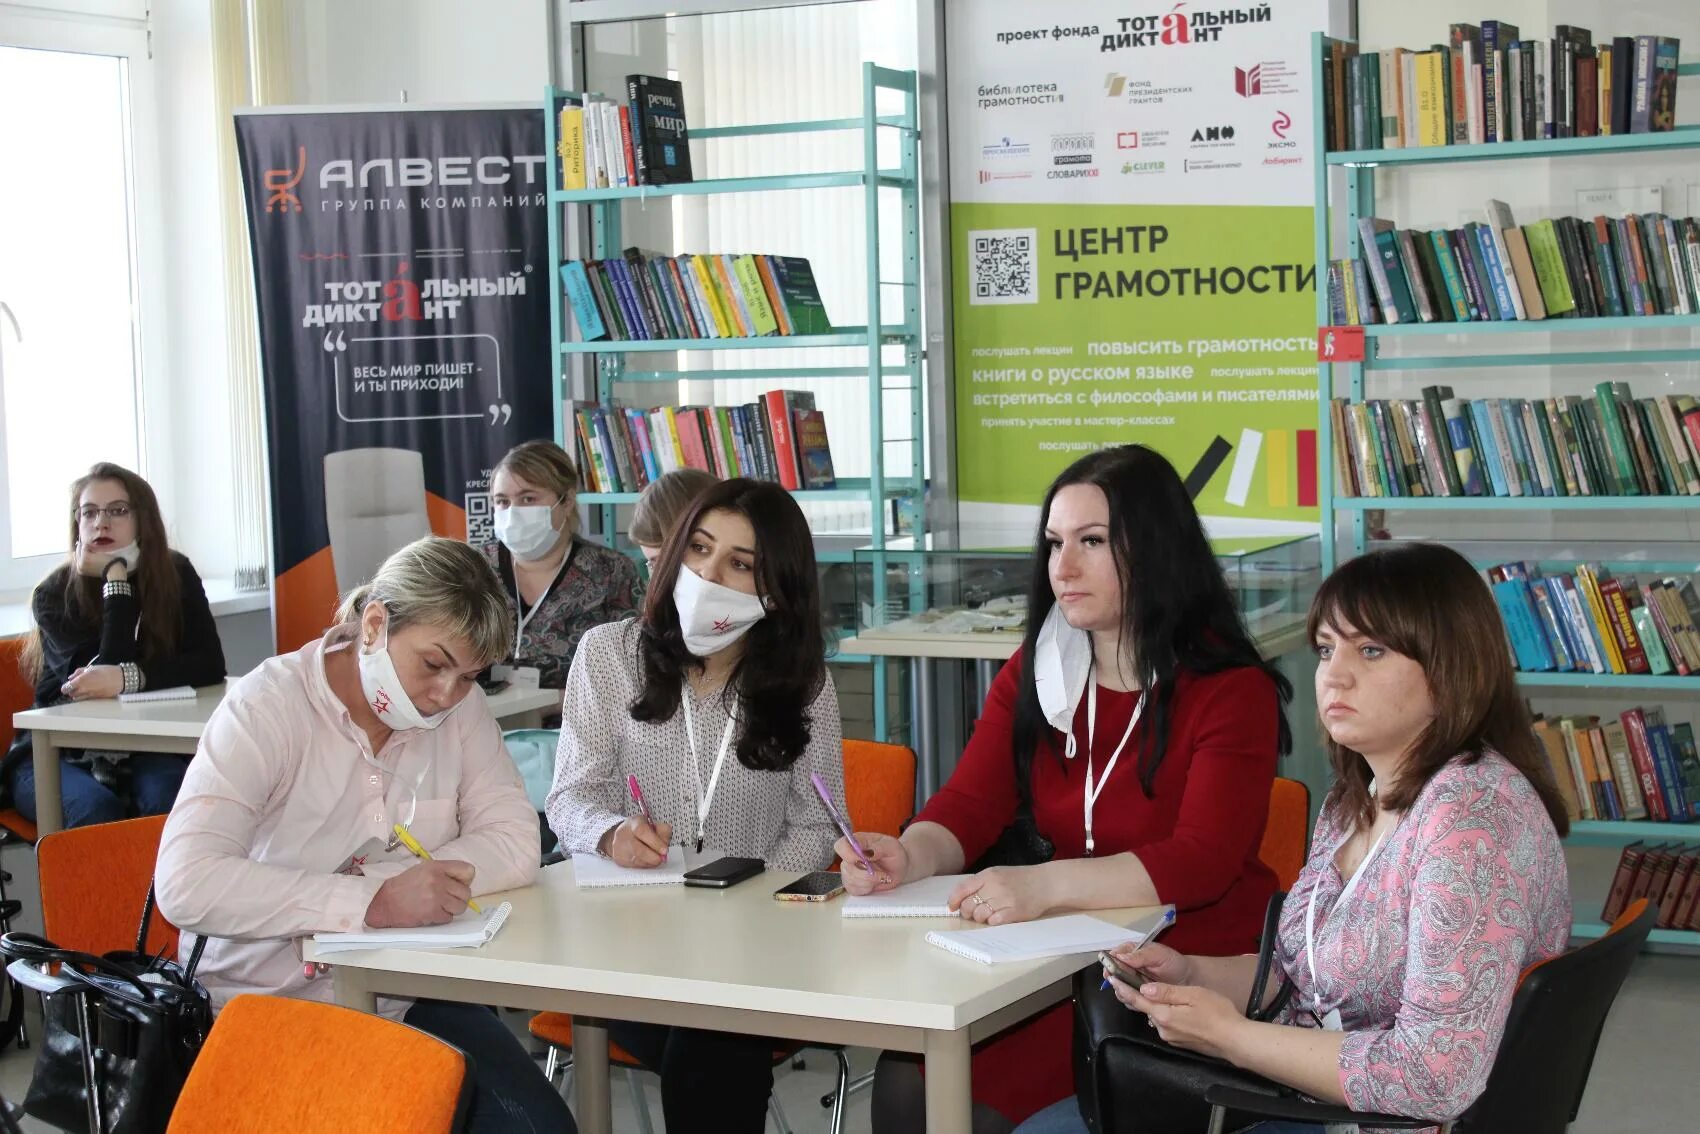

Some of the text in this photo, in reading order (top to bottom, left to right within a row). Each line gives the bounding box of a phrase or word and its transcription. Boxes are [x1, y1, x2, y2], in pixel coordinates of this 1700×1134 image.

[997, 24, 1099, 44] проект фонда
[1129, 81, 1152, 89] ФОНД
[1129, 87, 1192, 97] ПРЕЗИДЕНТСКИХ
[648, 94, 676, 109] речи,
[654, 115, 685, 138] мир
[319, 155, 546, 189] АЛВЕСТ
[1133, 161, 1165, 171] CLEVER
[321, 193, 546, 212] ГРУППА КОМПАНИЙ
[1054, 225, 1168, 262] ЦЕНТР
[1055, 264, 1317, 300] ГРАМОТНОСТИ
[972, 346, 1073, 358] послушать лекции
[1088, 338, 1318, 358] повысить грамотность
[354, 366, 387, 378] ВЕСЬ
[390, 364, 421, 377] МИР
[425, 363, 474, 376] ПИШЕТ
[972, 365, 1194, 385] книги о русском языке
[1211, 367, 1273, 378] послушать
[354, 378, 464, 392] И ТЫ ПРИХОДИ!
[973, 388, 1320, 408] встретиться с философами и писателями
[982, 415, 1175, 429] принять участие в мастер-классах
[1040, 441, 1099, 452] послушать
[465, 480, 491, 488] КРЕСЛ
